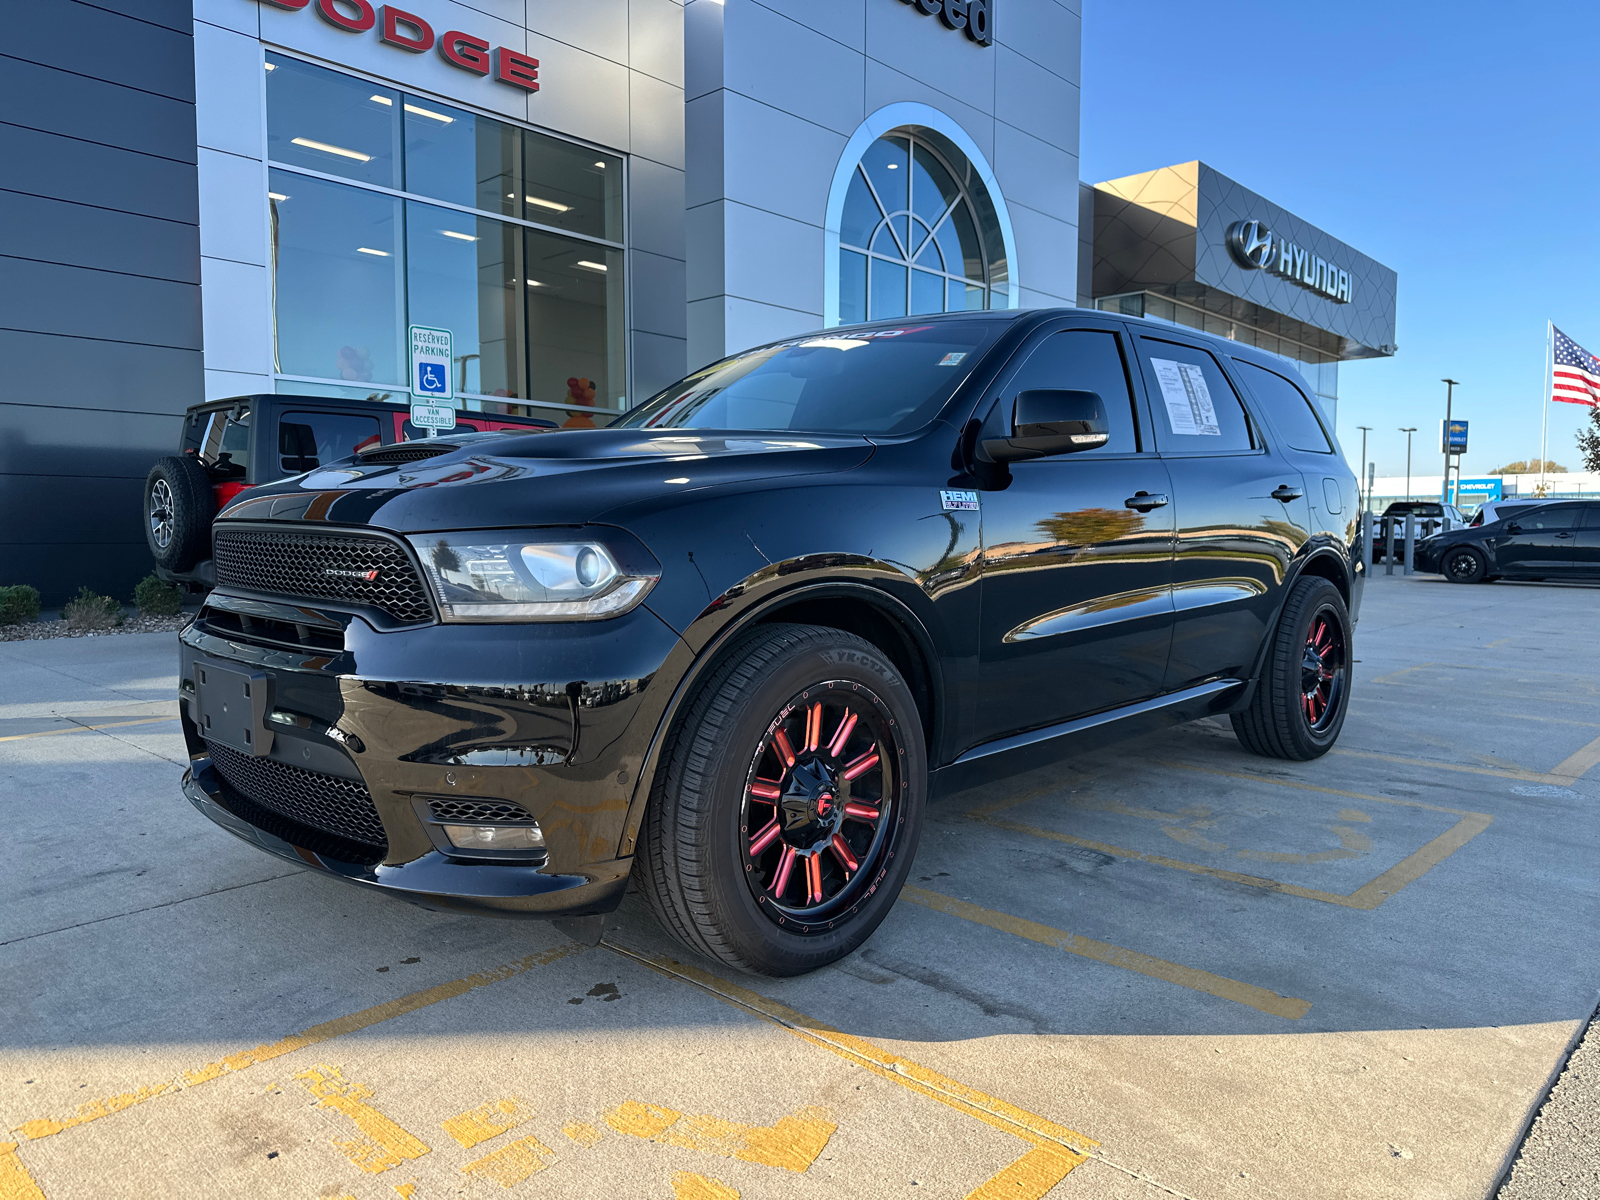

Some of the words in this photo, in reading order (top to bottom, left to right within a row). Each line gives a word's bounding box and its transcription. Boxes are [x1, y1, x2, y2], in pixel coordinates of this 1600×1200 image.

[257, 0, 540, 94] ODGE
[1278, 238, 1353, 304] HYUNDAI
[414, 333, 449, 346] RESERVED
[414, 345, 450, 358] PARKING
[415, 416, 452, 425] ACCESSIBLE
[326, 569, 370, 578] DODGE
[767, 703, 796, 736] FUEL
